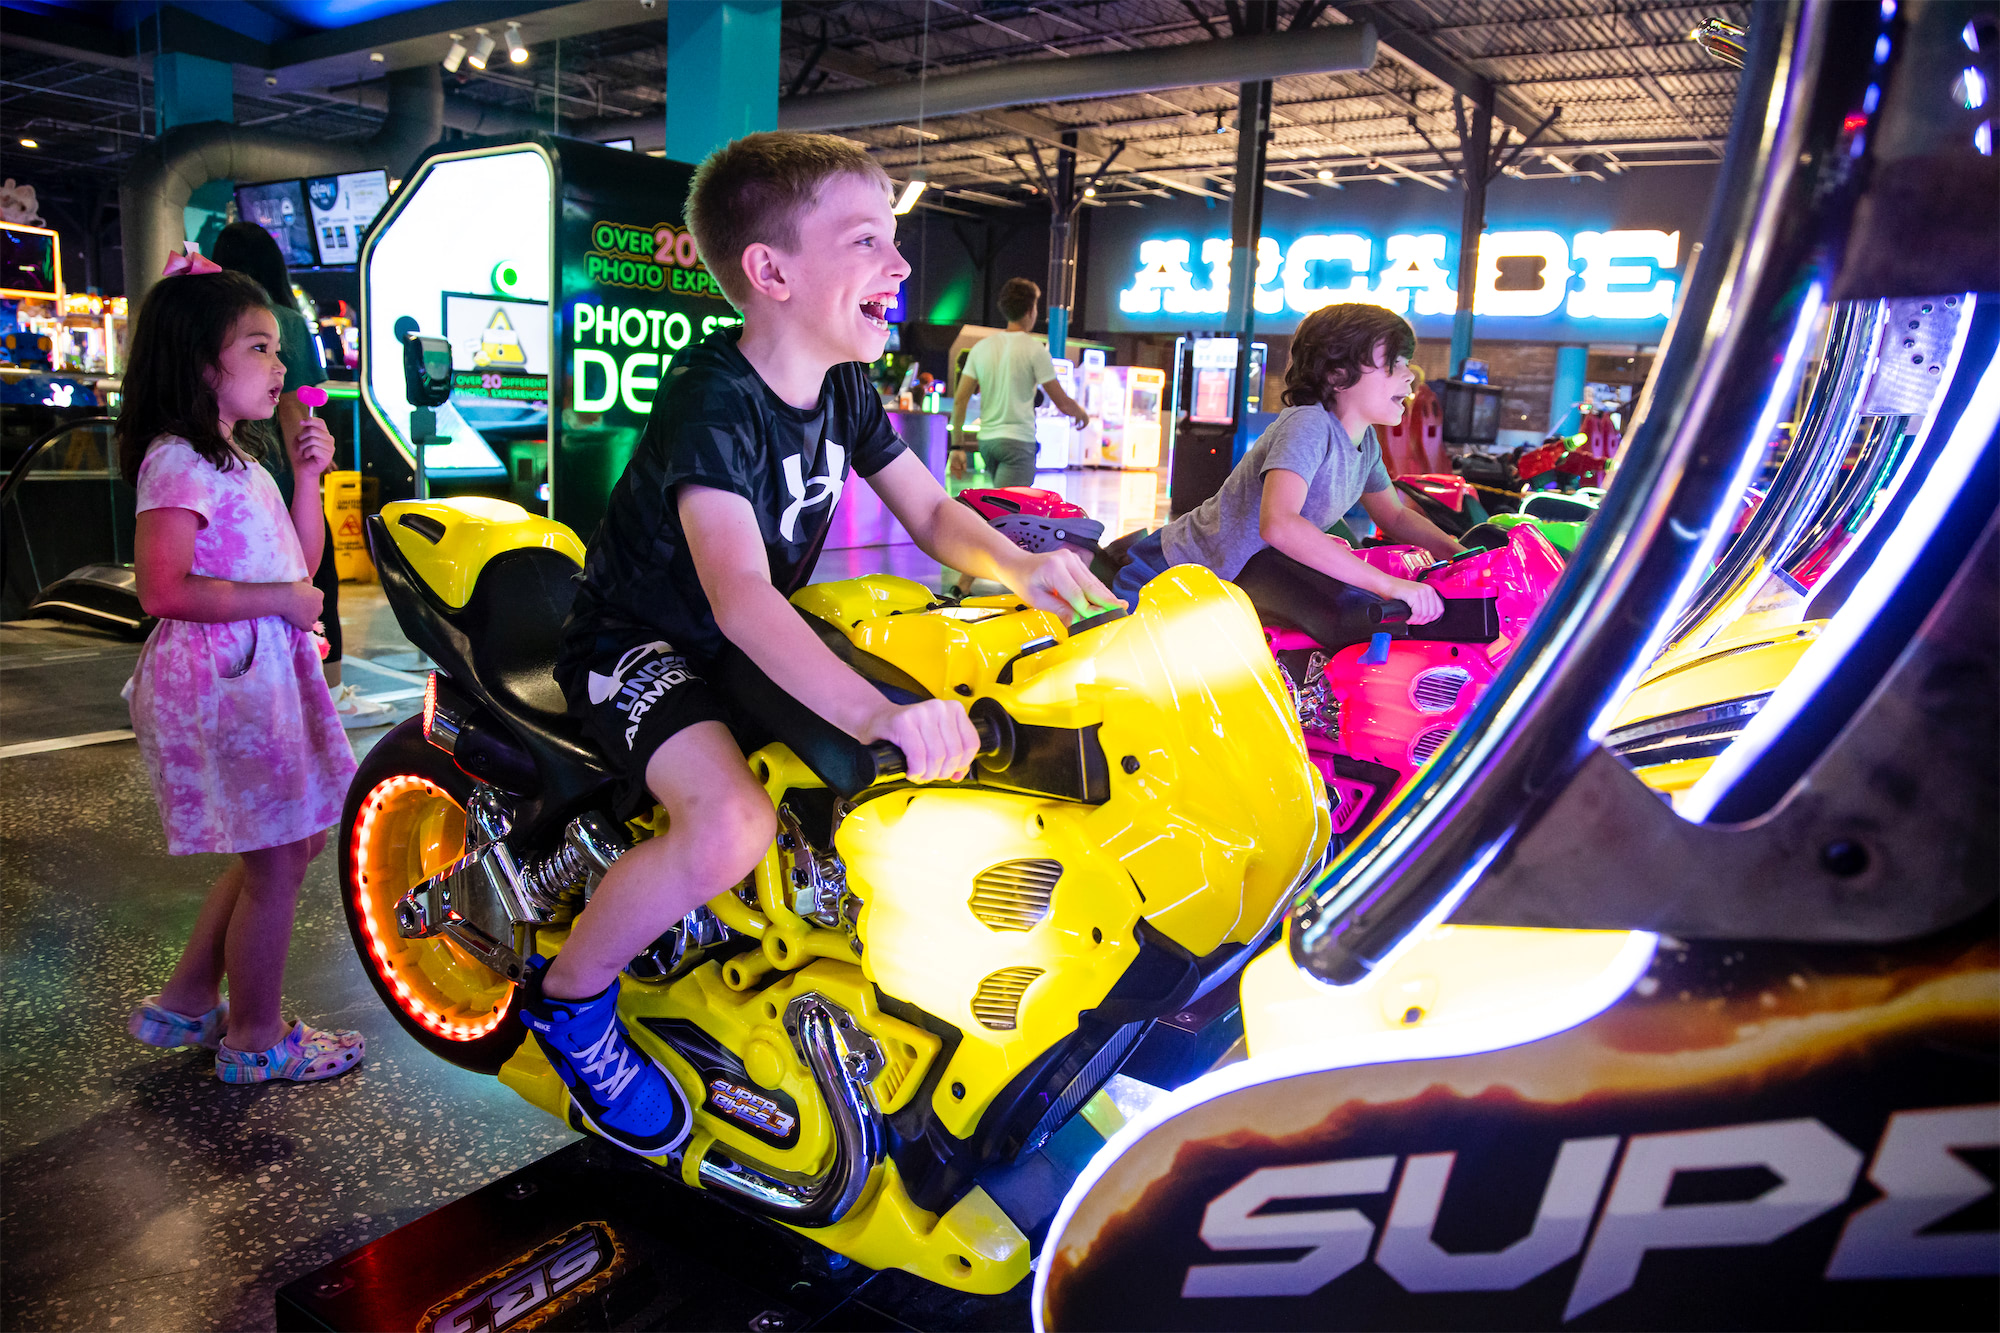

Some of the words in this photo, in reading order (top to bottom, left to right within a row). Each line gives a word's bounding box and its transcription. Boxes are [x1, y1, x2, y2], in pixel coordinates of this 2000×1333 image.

[596, 225, 654, 253] OVER
[654, 229, 697, 267] 20
[588, 256, 663, 286] PHOTO
[1119, 229, 1680, 318] ARCADE
[573, 302, 692, 350] PHOTO
[456, 375, 482, 386] OVER
[481, 373, 502, 389] 20
[533, 1020, 551, 1032] NIKE
[711, 1080, 778, 1114] SUPER
[712, 1093, 771, 1123] BIKES
[774, 1110, 795, 1136] 3
[1181, 1103, 2000, 1324] SUPE
